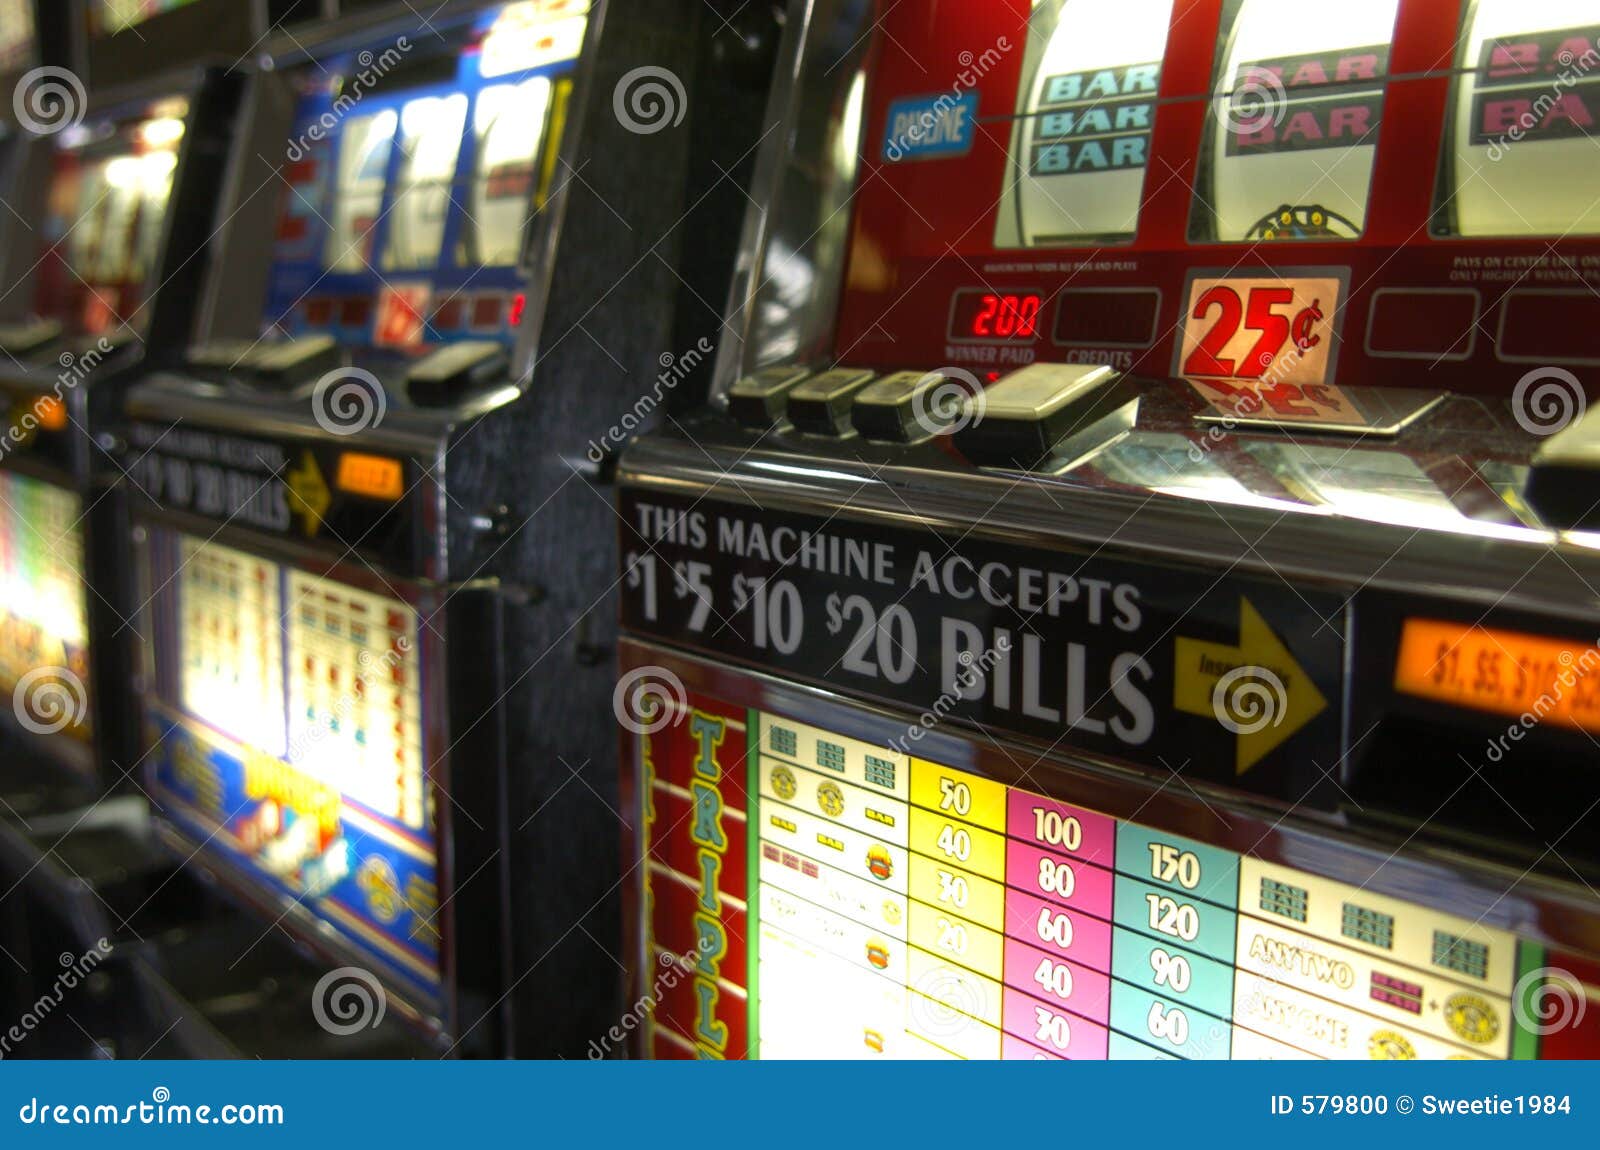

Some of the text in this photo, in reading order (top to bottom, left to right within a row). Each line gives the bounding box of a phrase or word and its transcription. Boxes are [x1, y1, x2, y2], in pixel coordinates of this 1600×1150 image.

[1247, 55, 1377, 91] BAR
[1488, 36, 1600, 78] BA
[1047, 64, 1159, 101] BAR
[1040, 104, 1150, 138] BAR
[1236, 106, 1371, 146] BAR
[1483, 93, 1600, 134] BA
[1036, 137, 1147, 173] BAR
[973, 295, 1040, 337] 200
[945, 345, 1035, 364] WINNER PAID
[1067, 349, 1132, 368] CREDITS
[636, 502, 1142, 632] THIS MACHINE ACCEPTS
[625, 551, 657, 621] $1
[674, 560, 713, 633] $5
[732, 571, 804, 656] $10
[825, 591, 918, 685] $20
[941, 615, 1154, 745] BILLS
[939, 776, 971, 816] 50
[937, 824, 971, 862] 40
[1033, 807, 1082, 851] 100
[1038, 856, 1075, 899] 80
[1149, 842, 1200, 890] 150
[937, 871, 969, 909] 30
[1037, 907, 1073, 949] 60
[1146, 894, 1199, 942] 120
[1033, 957, 1073, 999] 40
[1150, 948, 1191, 993] 90
[1034, 1006, 1071, 1050] 30
[1148, 1001, 1189, 1046] 60
